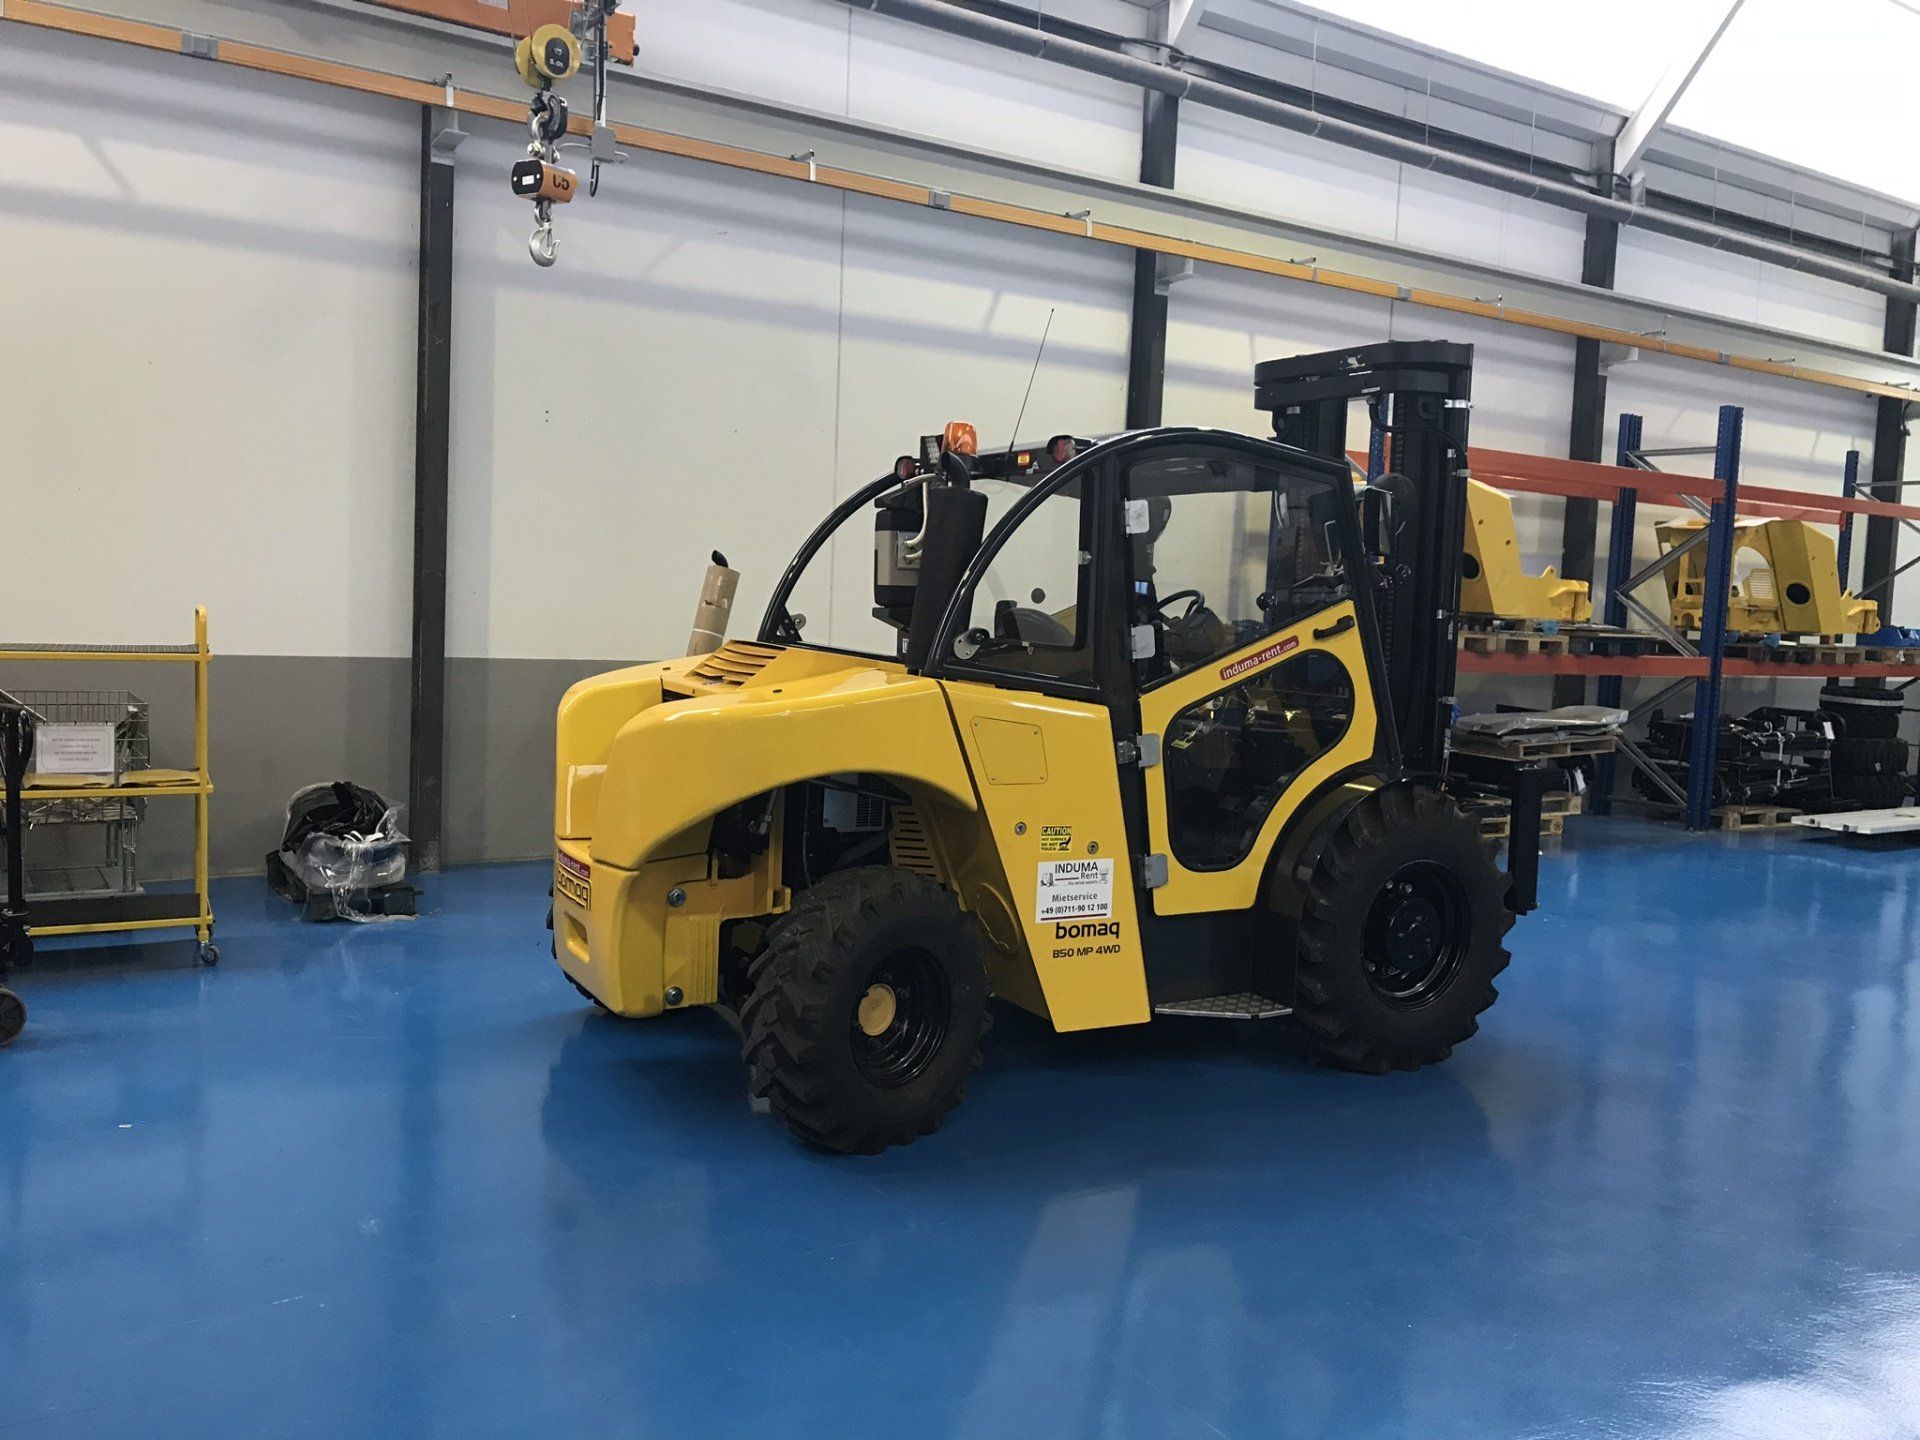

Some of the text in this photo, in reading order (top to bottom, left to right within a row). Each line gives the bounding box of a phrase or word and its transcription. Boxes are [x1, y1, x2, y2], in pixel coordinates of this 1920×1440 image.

[1222, 641, 1297, 679] induma-rent.com
[1042, 826, 1072, 836] CAUTION
[1055, 861, 1098, 874] INDUMA
[1052, 892, 1098, 902] Mietservice
[1055, 904, 1086, 914] (0)711-90
[1056, 922, 1120, 939] bomaq
[1076, 946, 1094, 956] MP
[1096, 944, 1121, 954] 4WD
